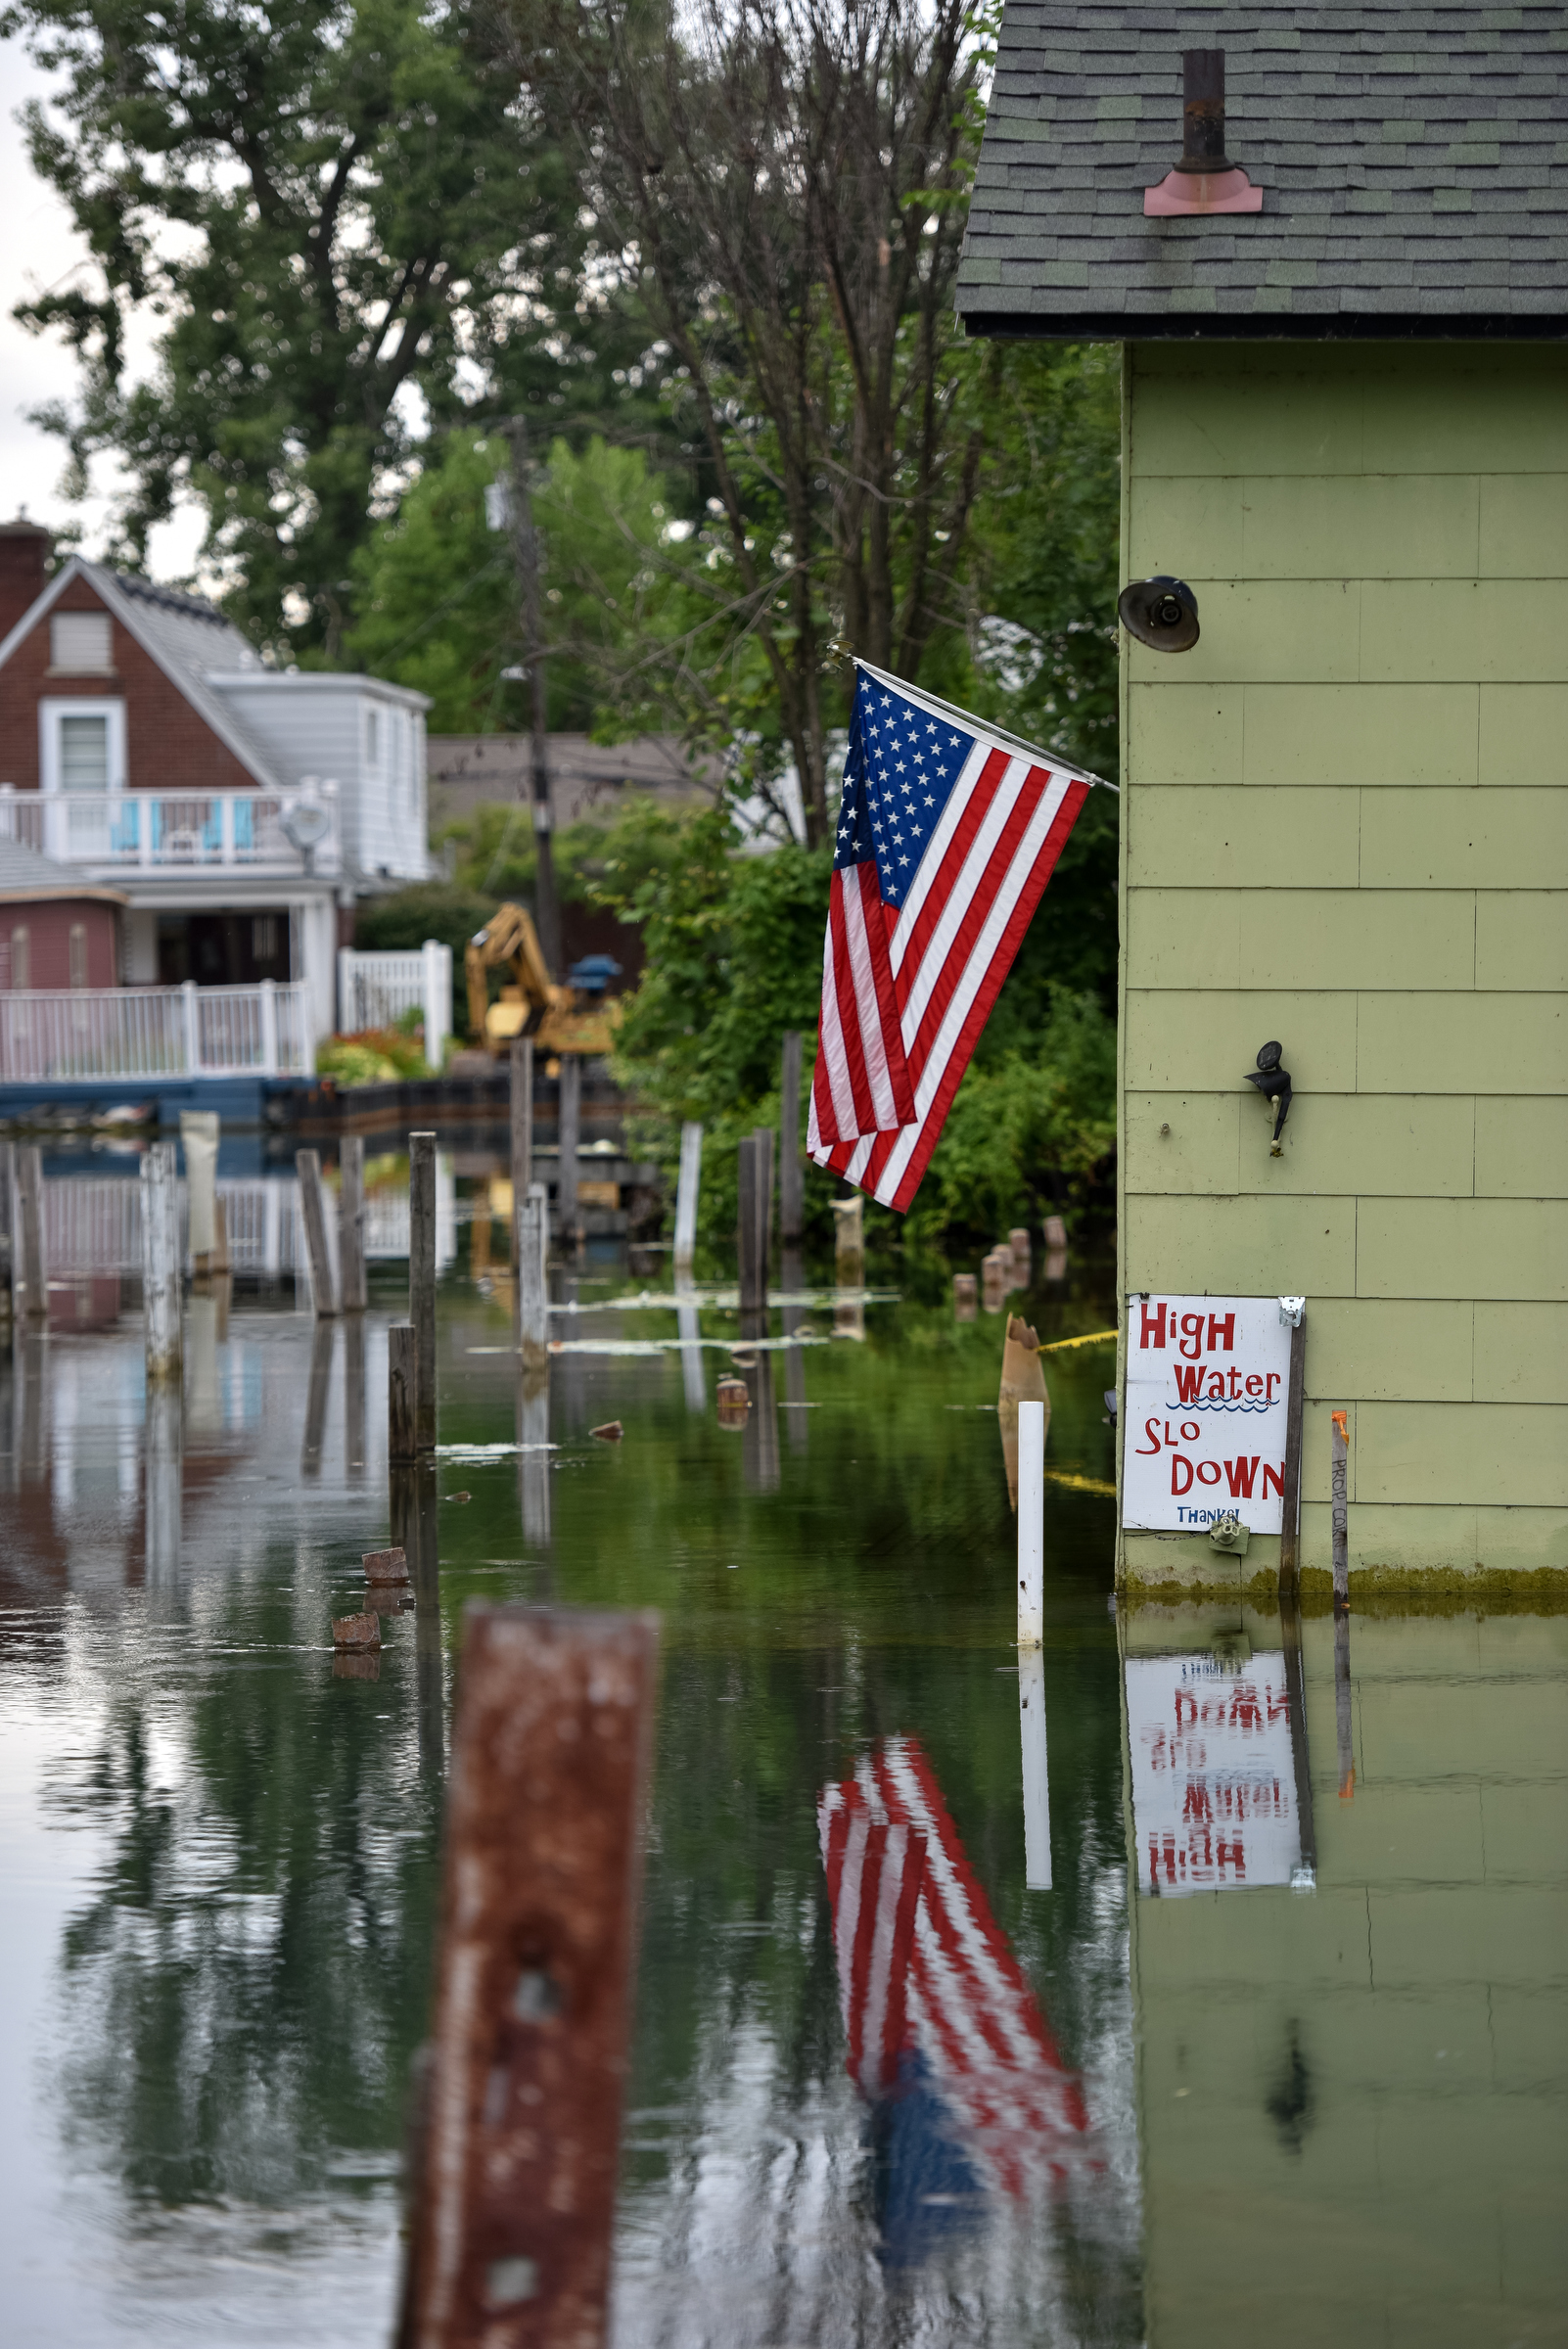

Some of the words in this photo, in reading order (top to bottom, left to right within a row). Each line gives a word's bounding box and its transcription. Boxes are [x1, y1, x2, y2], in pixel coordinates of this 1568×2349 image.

[1140, 1303, 1235, 1359] HigH
[1174, 1364, 1281, 1405] Water
[1135, 1418, 1201, 1455] SLO
[1172, 1454, 1285, 1500] DOWN
